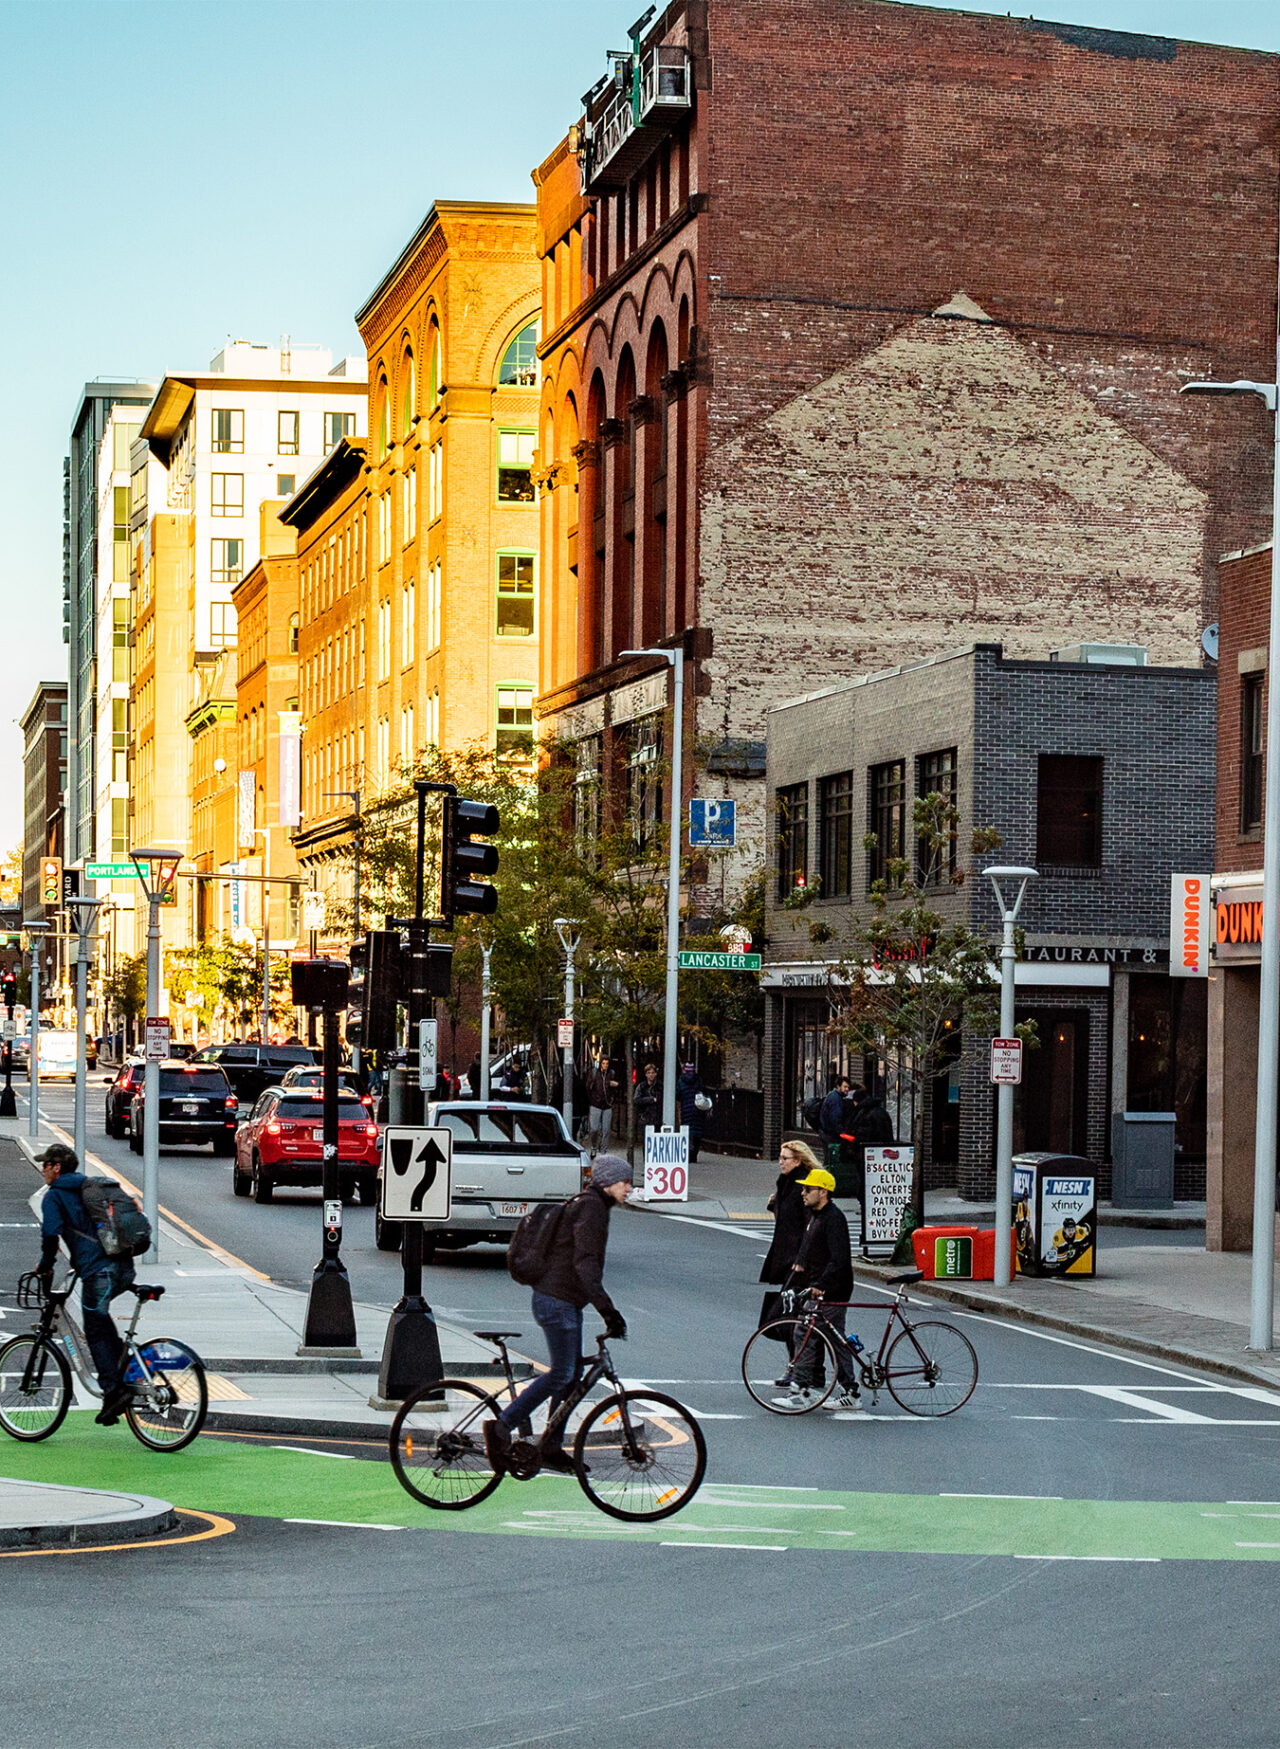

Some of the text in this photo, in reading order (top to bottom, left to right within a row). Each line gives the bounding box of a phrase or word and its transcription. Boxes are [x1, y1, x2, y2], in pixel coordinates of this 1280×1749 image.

[88, 866, 137, 876] PORTLAND
[1183, 879, 1200, 973] DUNKIN'
[1217, 901, 1264, 944] DUNK
[681, 954, 746, 967] LANCASTER
[1142, 950, 1156, 963] &
[646, 1136, 687, 1163] PARKING
[646, 1167, 686, 1195] $30
[880, 1174, 906, 1183] ELTON
[871, 1185, 912, 1195] CONCERTS
[1052, 1181, 1084, 1194] NESN
[874, 1196, 912, 1206] PATRIOTS
[1051, 1200, 1084, 1212] xfinity
[872, 1207, 887, 1216] RED
[876, 1218, 899, 1228] NO-FE
[945, 1240, 956, 1274] metro
